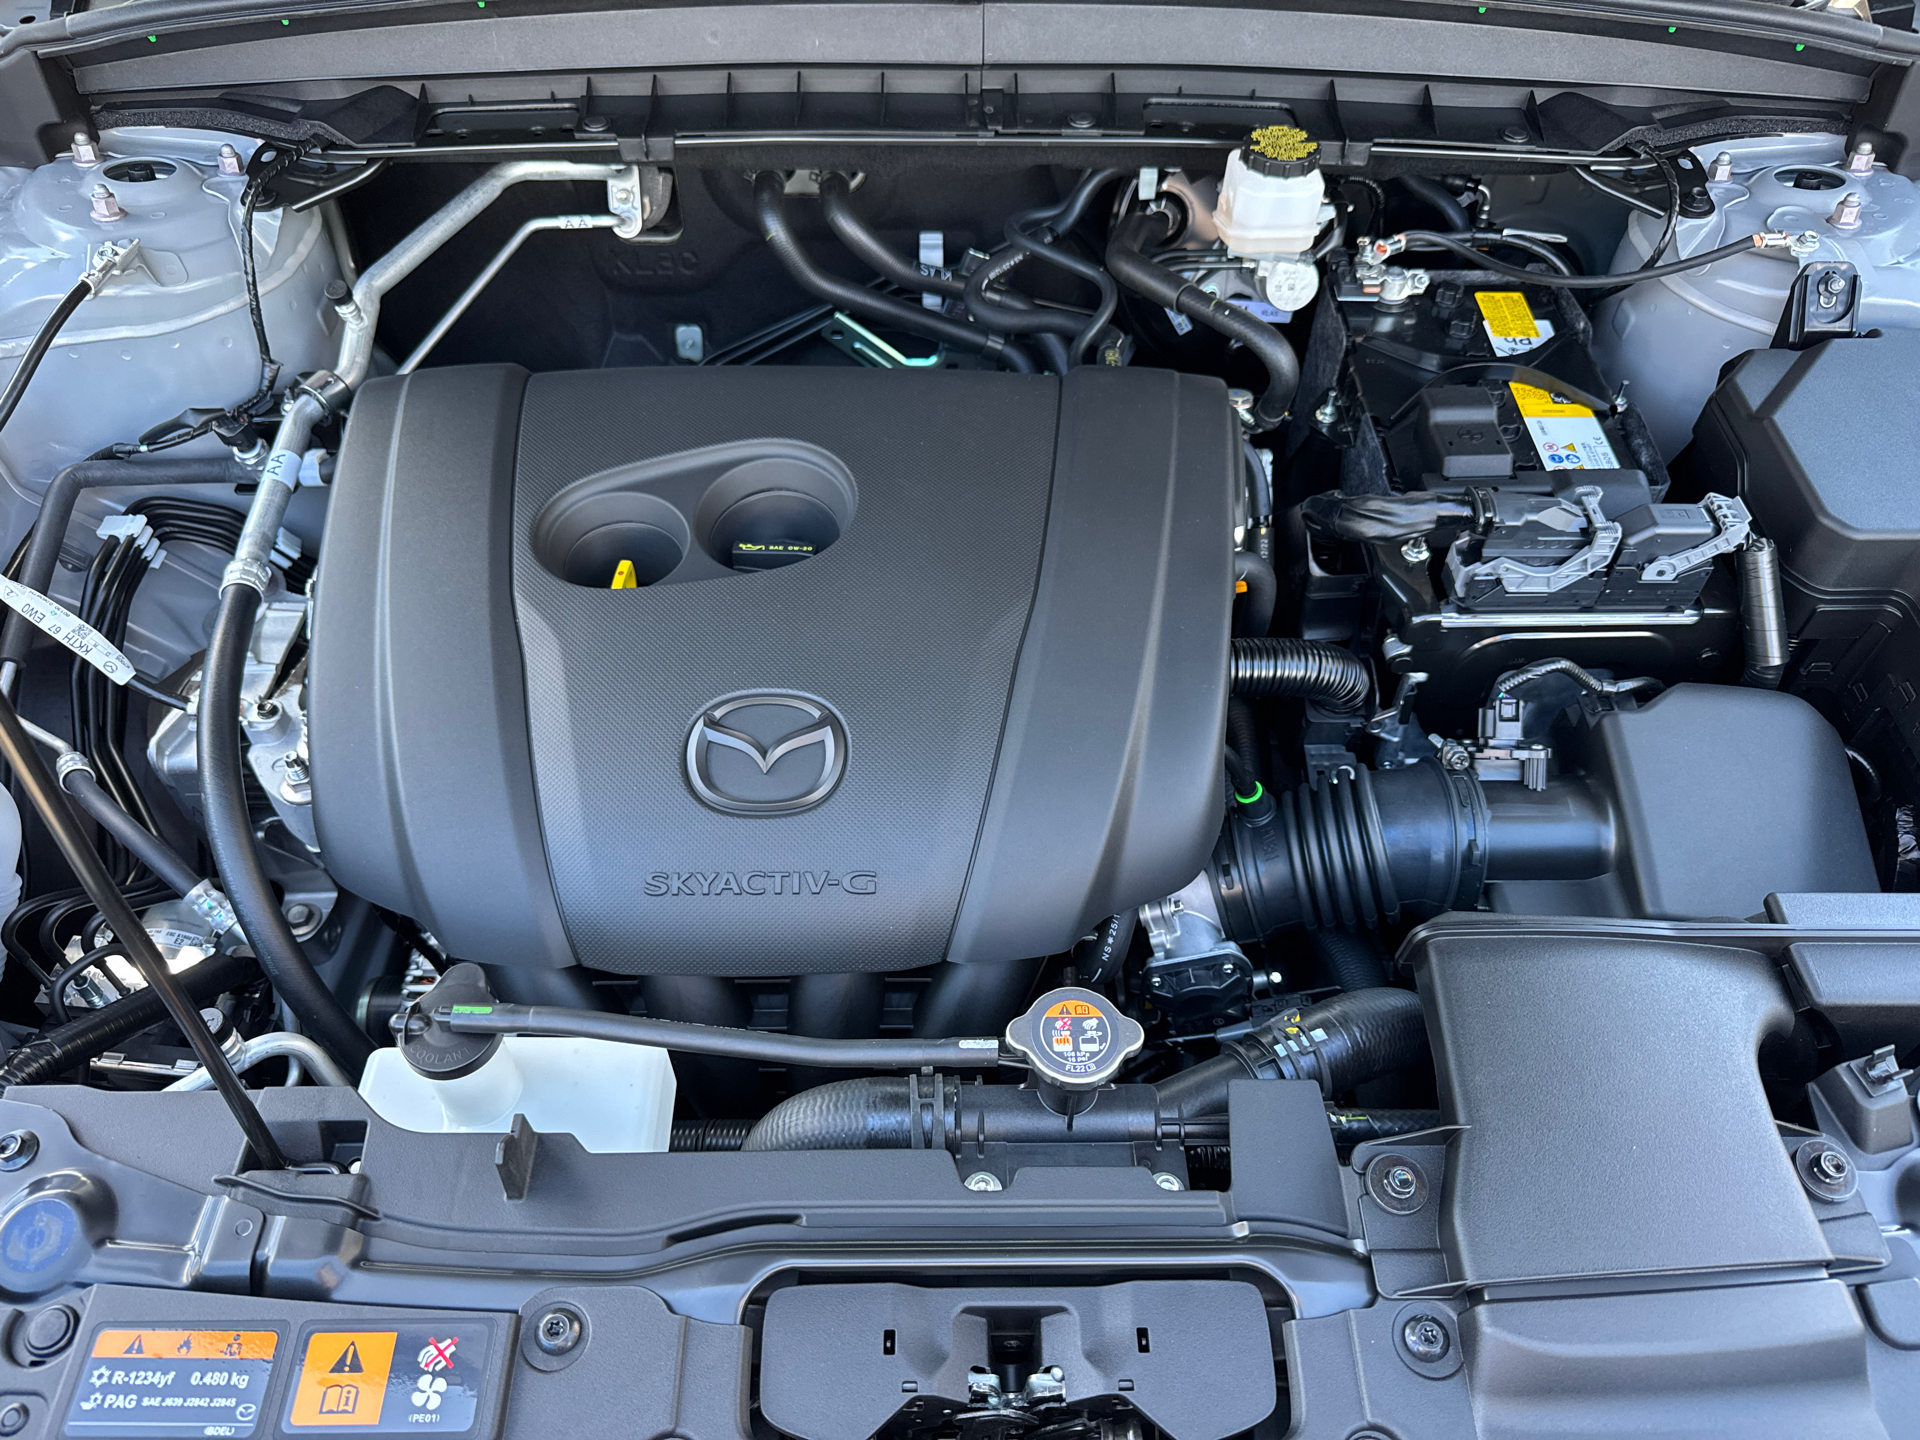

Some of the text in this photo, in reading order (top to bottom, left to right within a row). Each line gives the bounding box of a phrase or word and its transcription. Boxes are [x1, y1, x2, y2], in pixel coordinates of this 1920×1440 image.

[266, 454, 287, 477] AA
[47, 623, 62, 635] 67
[62, 632, 93, 656] KKTH
[643, 871, 877, 896] SKYACTIV-G
[410, 1044, 472, 1064] COOLANT
[1065, 1064, 1086, 1072] FL22
[112, 1371, 250, 1389] R-1234yf 0.480 kg
[103, 1394, 138, 1409] PAG
[141, 1396, 162, 1407] SAE
[409, 1413, 441, 1423] (PE01)
